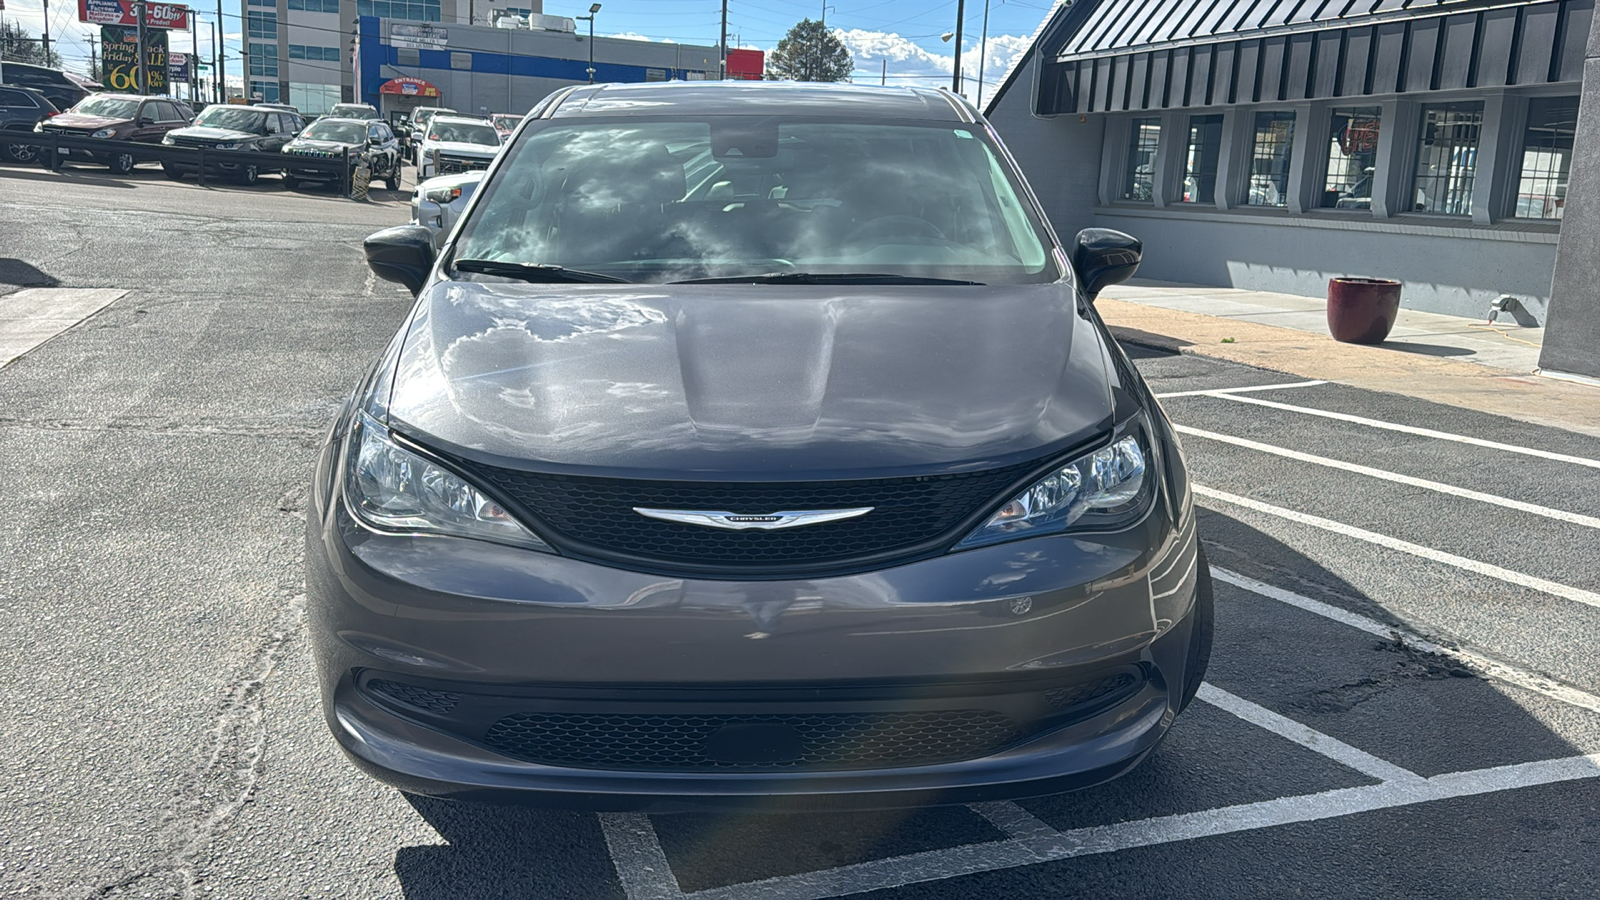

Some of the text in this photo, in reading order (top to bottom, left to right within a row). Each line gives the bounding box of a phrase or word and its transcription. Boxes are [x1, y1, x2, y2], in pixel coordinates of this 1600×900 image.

[102, 41, 136, 53] Spring
[102, 51, 165, 66] Friday SLE
[394, 77, 426, 86] ENTRANCE
